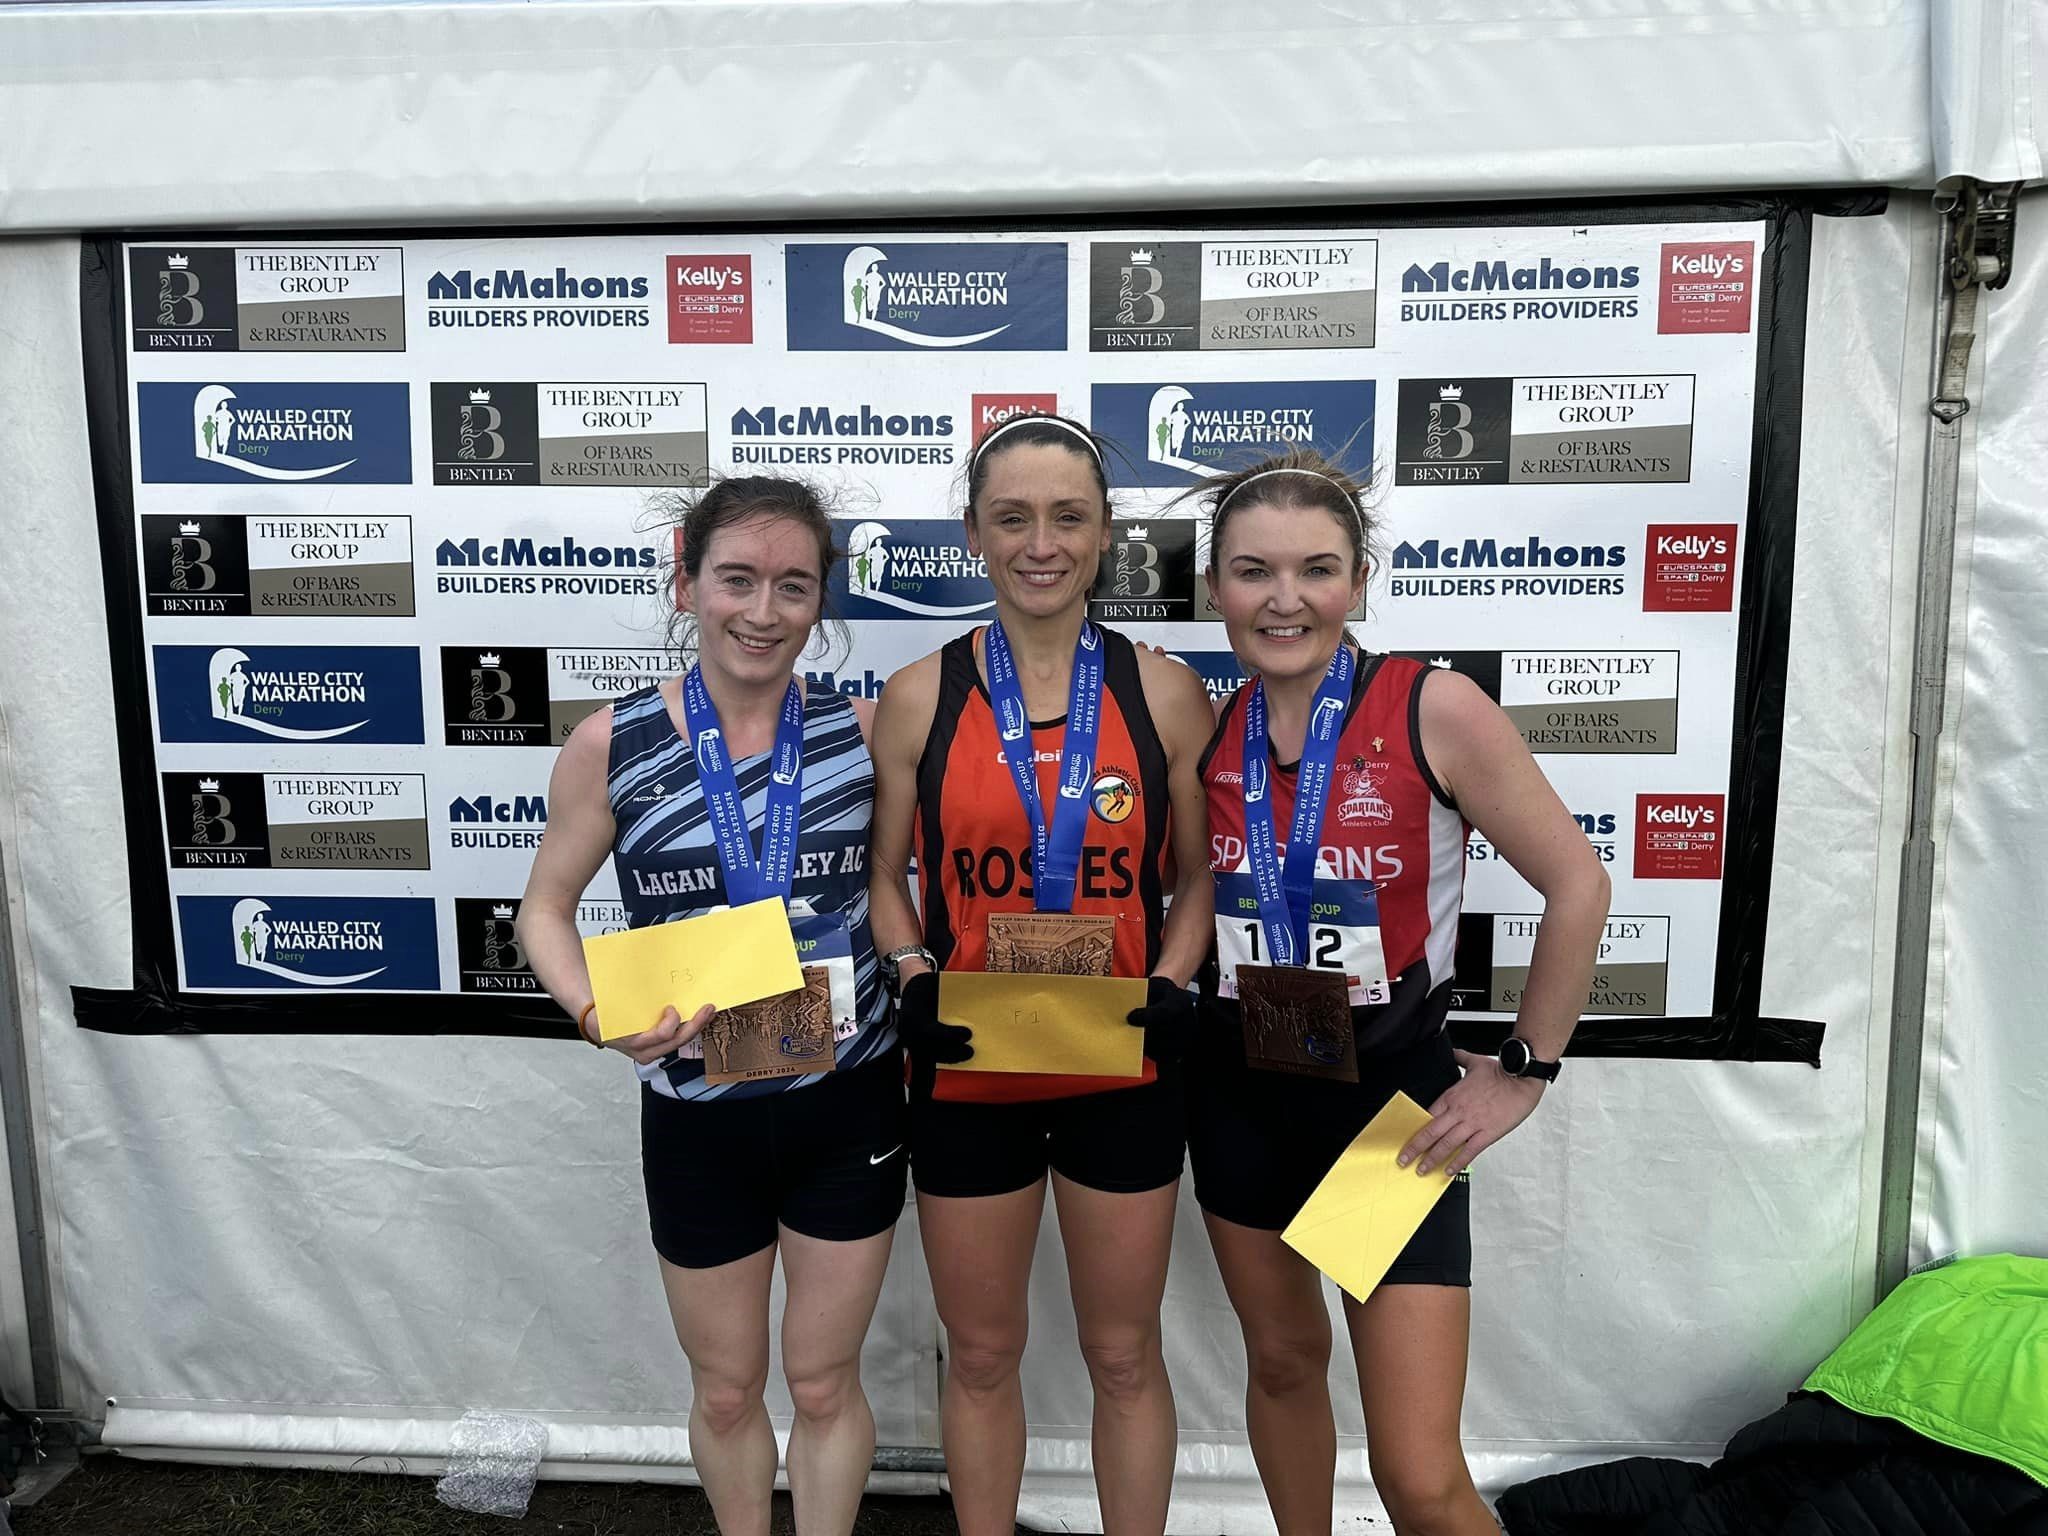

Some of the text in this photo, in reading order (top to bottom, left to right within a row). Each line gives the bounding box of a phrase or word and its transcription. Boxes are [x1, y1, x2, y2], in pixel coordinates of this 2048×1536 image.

[245, 255, 379, 272] THE BENTLEY
[1211, 248, 1353, 266] THE BENTLEY
[1672, 255, 1743, 278] Kelly's
[677, 266, 743, 290] Kelly's
[888, 272, 1007, 287] WALLED CITY
[1247, 272, 1319, 288] GROUP
[1402, 258, 1639, 292] McMahons
[280, 277, 349, 293] GROUP
[428, 267, 648, 299] McMahons
[888, 289, 1007, 305] MARATHON
[1718, 294, 1742, 303] Derry
[722, 306, 743, 314] Derry
[889, 309, 920, 321] Derry
[1247, 307, 1317, 322] OF BARS
[1401, 300, 1638, 321] BUILDERS PROVIDERS
[282, 311, 350, 325] OF BARS
[428, 310, 649, 327] BUILDERS PROVIDERS
[266, 328, 387, 341] RESTAURANTS
[1228, 324, 1355, 339] RESTAURANTS
[150, 335, 214, 346] BENTLEY
[1107, 333, 1174, 346] BENTLEY
[547, 391, 683, 407] THE BENTLEY
[1523, 384, 1669, 400] THE BENTLEY
[237, 410, 351, 423] WALLED CITY
[582, 412, 652, 428] GROUP
[731, 405, 953, 437] McMahons
[1193, 409, 1313, 425] WALLED CITY
[1559, 406, 1634, 422] GROUP
[237, 425, 352, 440] MARATHON
[1193, 425, 1313, 442] MARATHON
[239, 444, 269, 456] Derry
[584, 446, 652, 460] OF BARS
[732, 447, 953, 464] BUILDERS PROVIDERS
[1193, 446, 1224, 457] Derry
[1558, 441, 1631, 456] OF BARS
[566, 463, 690, 477] RESTAURANTS
[1539, 458, 1670, 472] RESTAURANTS
[450, 468, 515, 481] BENTLEY
[1413, 468, 1484, 480] BENTLEY
[256, 523, 388, 538] THE BENTLEY
[291, 544, 358, 559] GROUP
[436, 537, 656, 567] McMahons
[891, 546, 960, 560] WALLED
[1392, 537, 1625, 568] McMahons
[1658, 537, 1726, 559] Kelly's
[891, 560, 989, 577] MARATHO
[293, 577, 360, 590] OF BARS
[438, 577, 657, 594] BUILDERS PROVIDERS
[892, 580, 922, 592] Derry
[1702, 574, 1724, 583] Derry
[1391, 577, 1624, 597] BUILDERS PROVIDERS
[164, 599, 227, 611] BENTLEY
[276, 593, 396, 606] RESTAURANTS
[1103, 604, 1170, 617] BENTLEY
[557, 656, 691, 672] THE BENTLEY
[1512, 659, 1654, 674] THE BENTLEY
[252, 672, 363, 686] WALLED CITY
[592, 676, 661, 690] GROUP
[252, 687, 365, 702] MARATHON
[1547, 679, 1620, 695] GROUP
[254, 704, 283, 716] Derry
[1547, 713, 1619, 726] OF BARS
[462, 730, 527, 741] BENTLEY
[1528, 730, 1657, 743] RESTAURANTS
[1365, 762, 1390, 770] Derry
[1302, 762, 1314, 793] DERRY
[273, 781, 402, 796] THE BENTLEY
[1312, 763, 1326, 809] BENTLEY
[307, 801, 373, 815] GROUP
[1340, 802, 1391, 818] SPARTANS
[1647, 805, 1715, 828] Kelly's
[712, 794, 725, 824] DERRY
[724, 841, 736, 871] MILER
[724, 791, 748, 868] BENTLEY GROUP
[311, 832, 375, 844] OF BARS
[766, 804, 780, 881] BENTLEY GROUP
[778, 805, 793, 882] DERRY 10 MILER
[296, 848, 411, 860] RESTAURANTS
[1692, 843, 1713, 852] Derry
[186, 852, 247, 864] BENTLEY
[840, 845, 865, 874] AC
[1212, 835, 1403, 880] SPANS
[952, 847, 1133, 898] ROSES
[633, 867, 717, 896] LAGAN
[273, 921, 381, 934] WALLED CITY
[274, 935, 382, 950] MARATHON
[276, 951, 304, 962] Derry
[476, 977, 537, 988] BENTLEY
